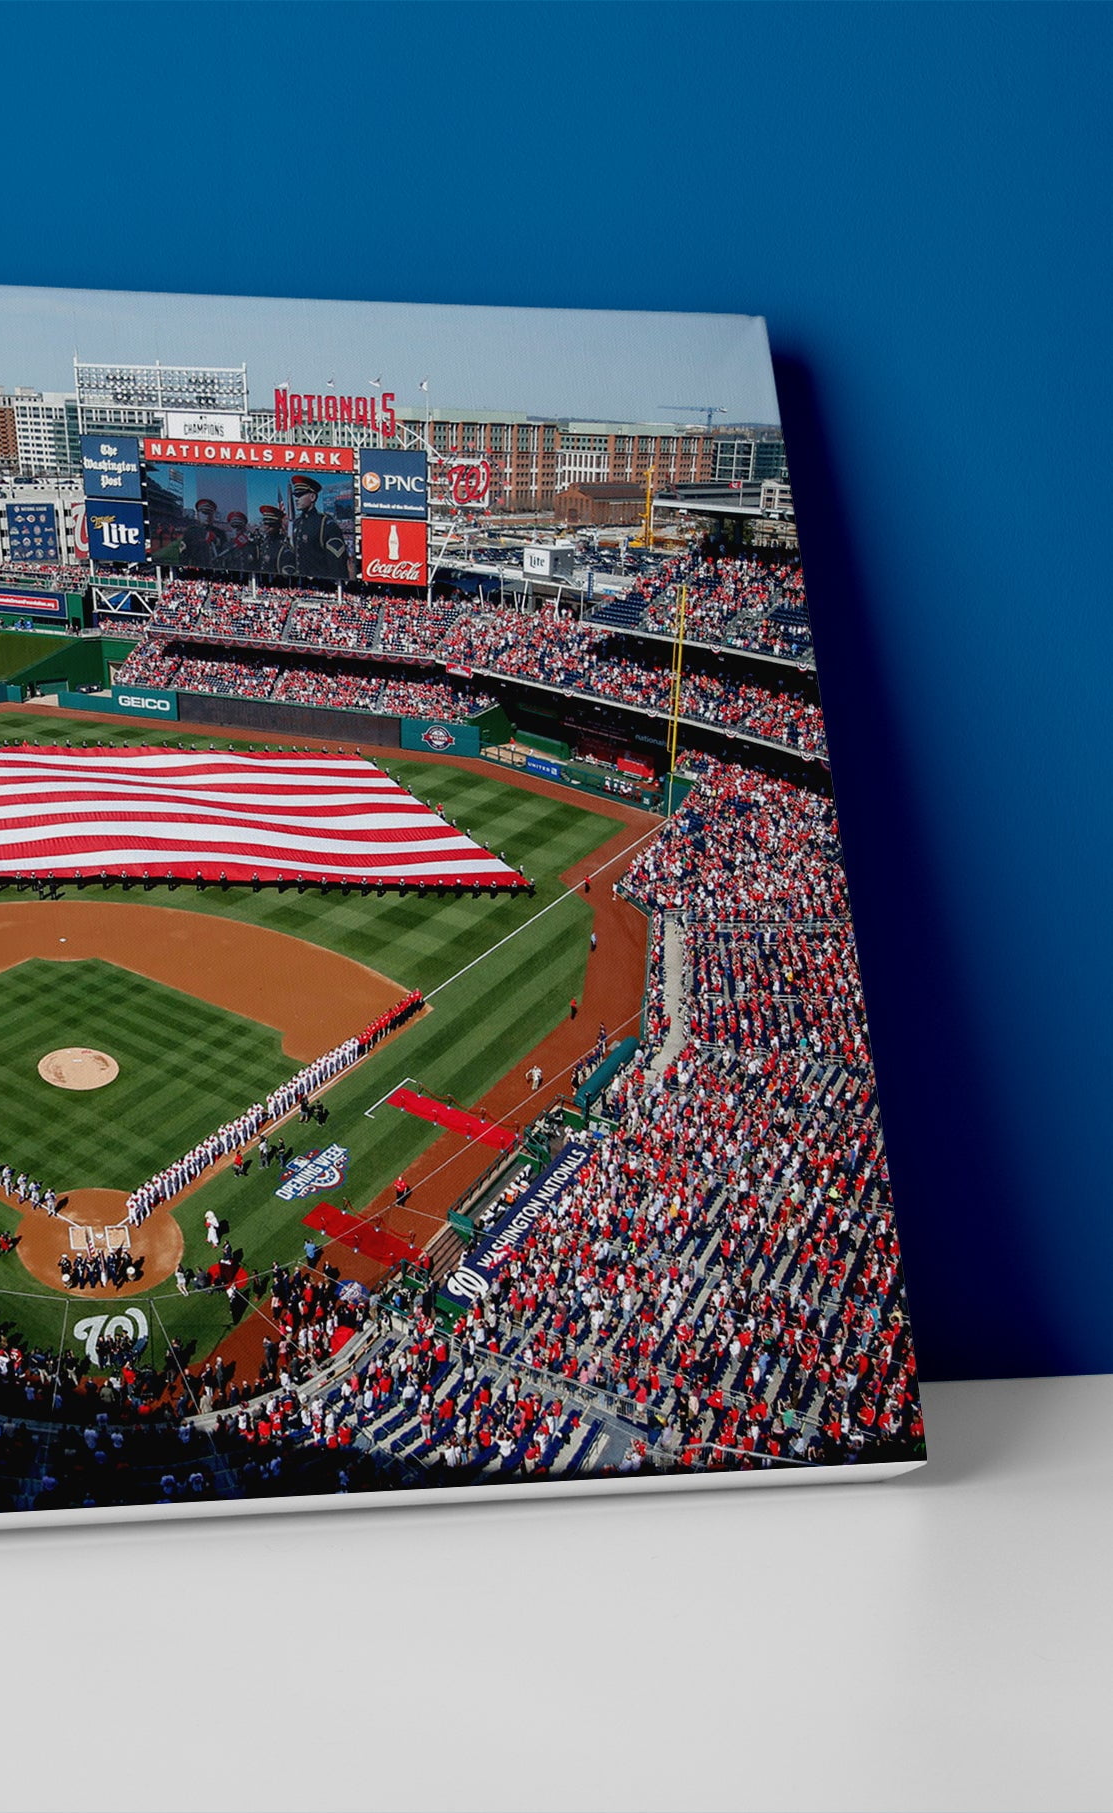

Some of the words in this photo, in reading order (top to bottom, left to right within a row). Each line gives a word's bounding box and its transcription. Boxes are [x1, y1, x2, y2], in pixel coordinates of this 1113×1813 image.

[274, 389, 396, 438] NATIONALS
[183, 424, 225, 437] CHAMPIONS
[99, 444, 118, 456] The
[151, 443, 274, 462] NATIONALS
[285, 448, 342, 466] PARK
[83, 456, 138, 474] Washington
[101, 474, 122, 488] Post
[383, 474, 425, 492] PNC
[101, 522, 140, 549] Lite
[367, 559, 423, 580] Coca-Cola
[529, 555, 545, 568] Lite
[117, 695, 171, 711] GEICO
[527, 761, 551, 772] UNITED
[275, 1163, 323, 1200] OPENING
[313, 1143, 347, 1167] WEEK
[476, 1192, 544, 1268] WASHINGTON
[538, 1148, 586, 1204] NATIONALS
